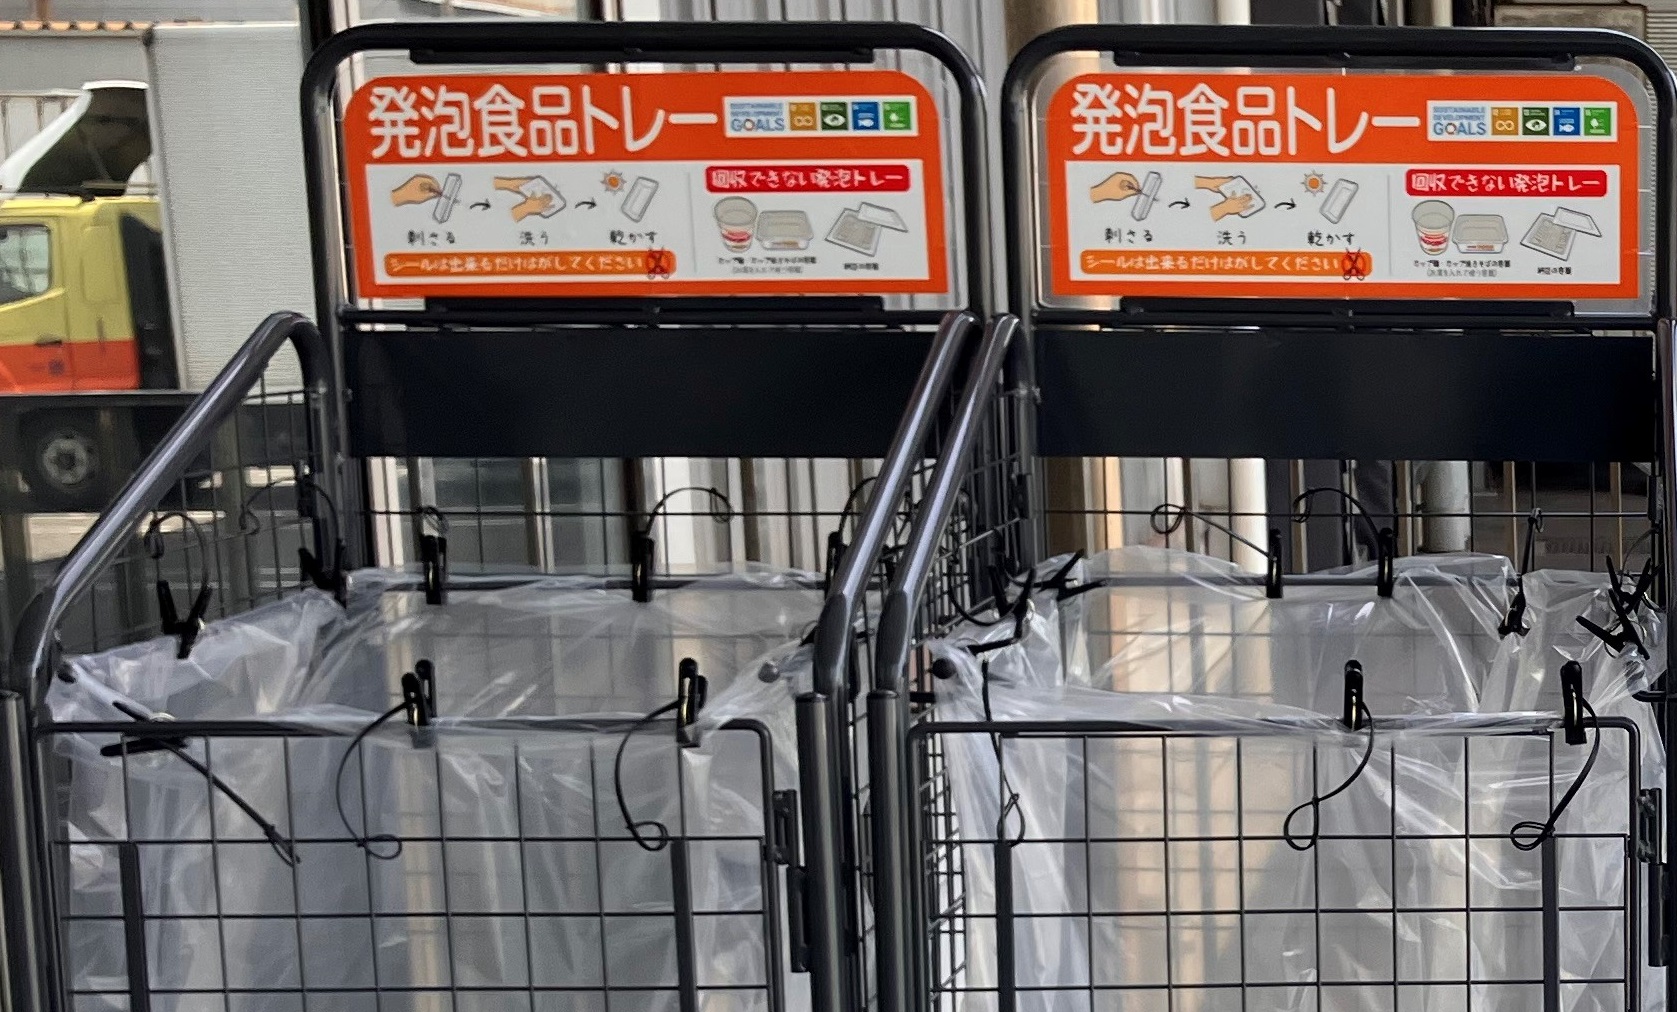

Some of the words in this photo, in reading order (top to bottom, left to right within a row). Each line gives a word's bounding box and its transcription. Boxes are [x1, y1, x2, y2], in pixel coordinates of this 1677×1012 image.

[369, 84, 718, 158] 発泡食品トレー
[731, 118, 784, 131] GOALS
[1070, 83, 1421, 156] 発泡食品トレー
[1433, 122, 1487, 135] GOALS
[1411, 173, 1600, 193] 回収できない発泡トレー
[1218, 230, 1247, 246] 洗う
[1307, 230, 1355, 246] 乾かす
[1086, 254, 1338, 271] シールは出来るだけはがしてください
